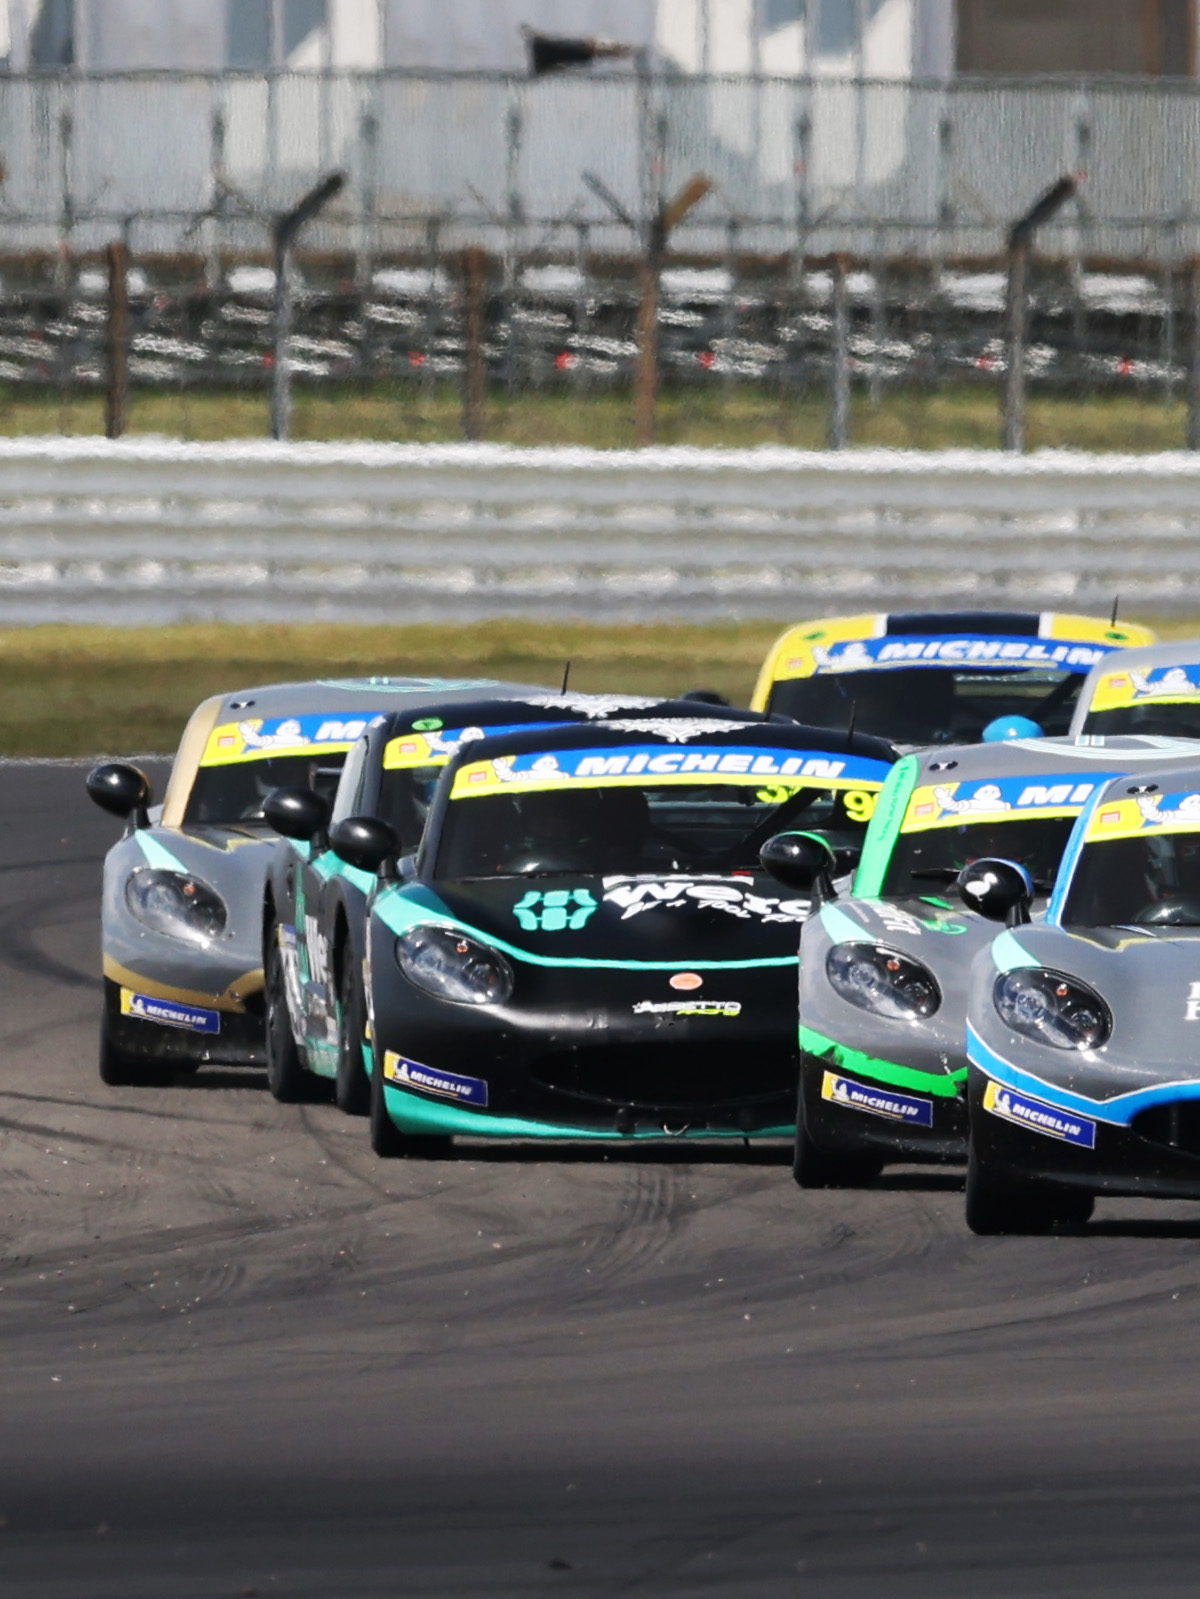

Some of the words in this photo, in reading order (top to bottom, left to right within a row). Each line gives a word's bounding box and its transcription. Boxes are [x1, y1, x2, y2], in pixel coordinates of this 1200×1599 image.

[878, 640, 1103, 666] MICHELIN
[575, 753, 846, 778] MICHELIN
[843, 790, 878, 822] 9
[147, 1005, 207, 1025] MICHELIN
[410, 1070, 472, 1096] MICHELIN
[850, 1091, 919, 1117] MICHELIN
[1011, 1103, 1082, 1136] MICHELIN
